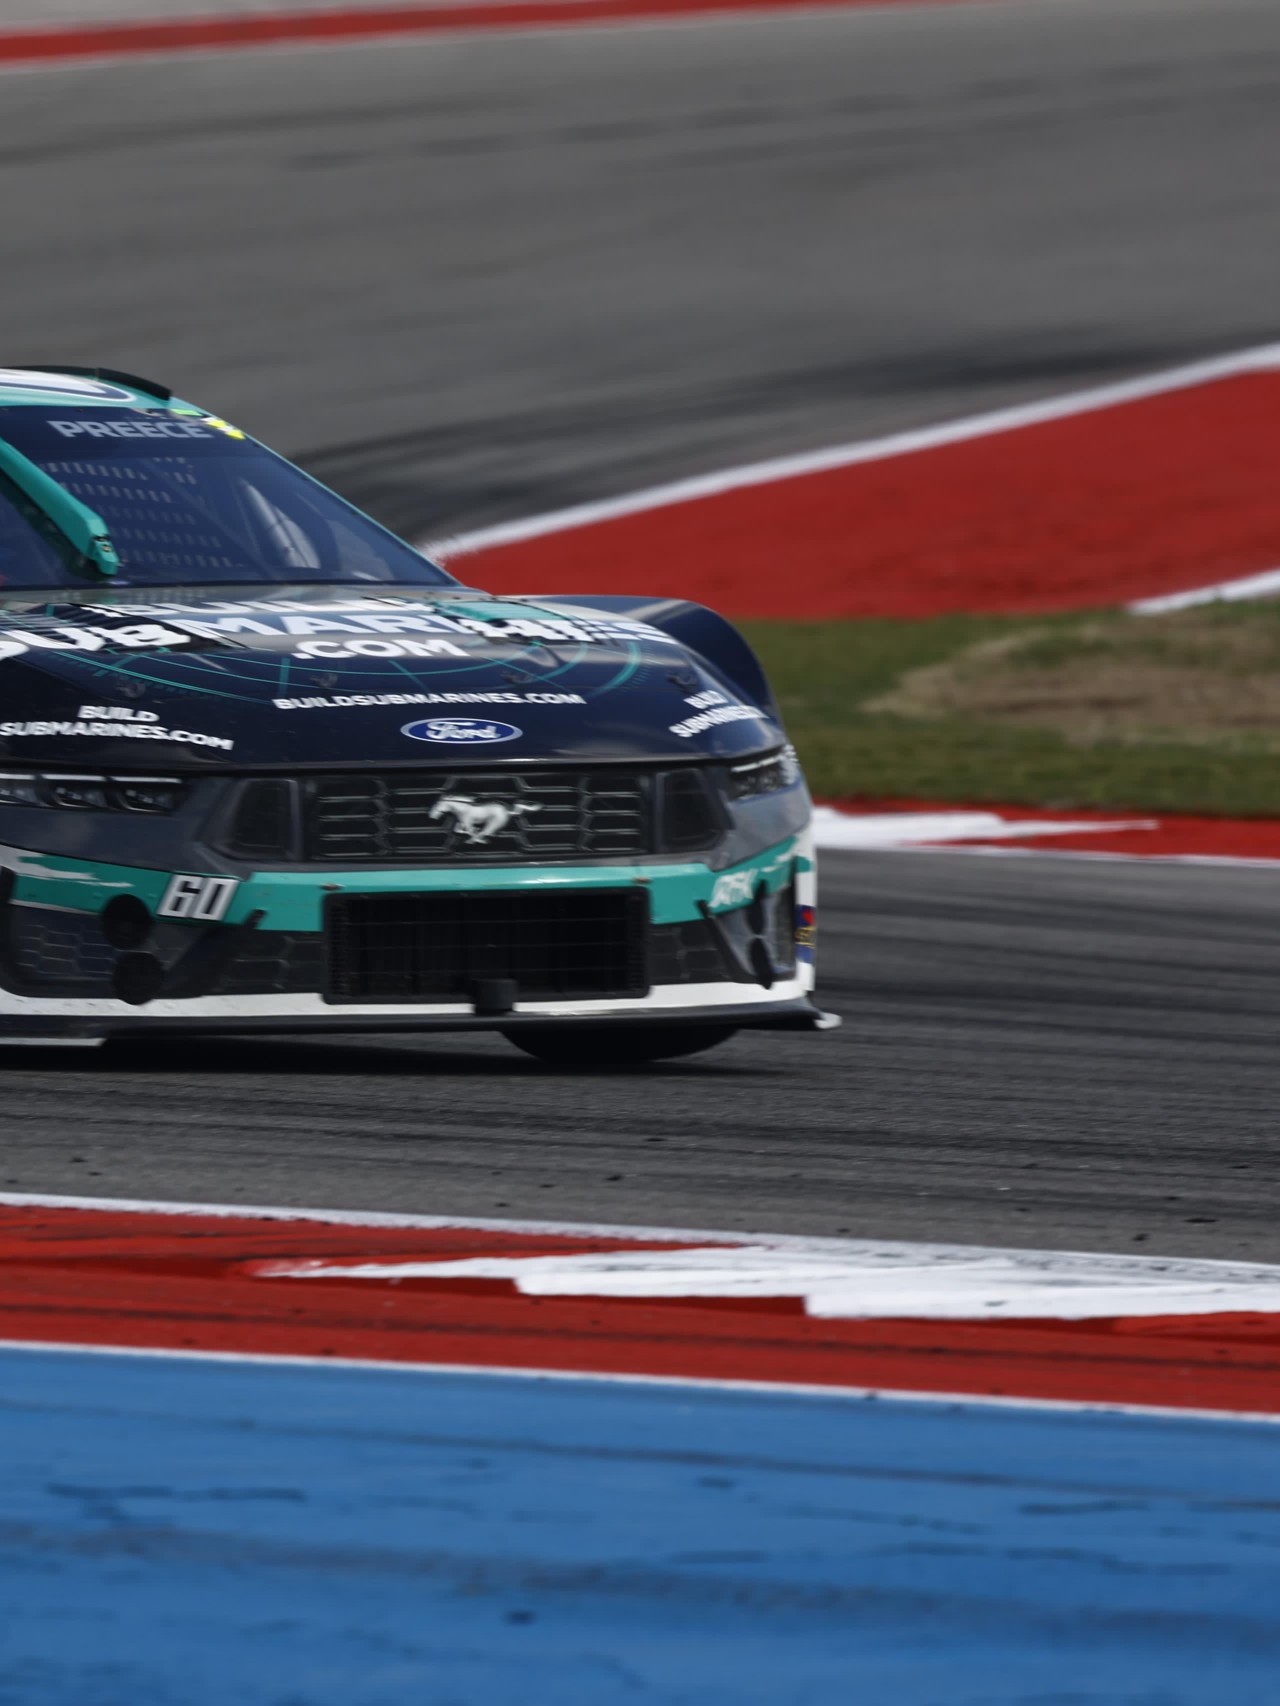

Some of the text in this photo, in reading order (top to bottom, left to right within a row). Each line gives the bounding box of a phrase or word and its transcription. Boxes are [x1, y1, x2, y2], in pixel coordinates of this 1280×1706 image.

[46, 420, 215, 439] PREECE
[291, 639, 470, 660] .COM
[274, 692, 588, 710] BUILDSUBMARINES.COM
[77, 704, 160, 722] BUILD
[157, 874, 240, 921] 60
